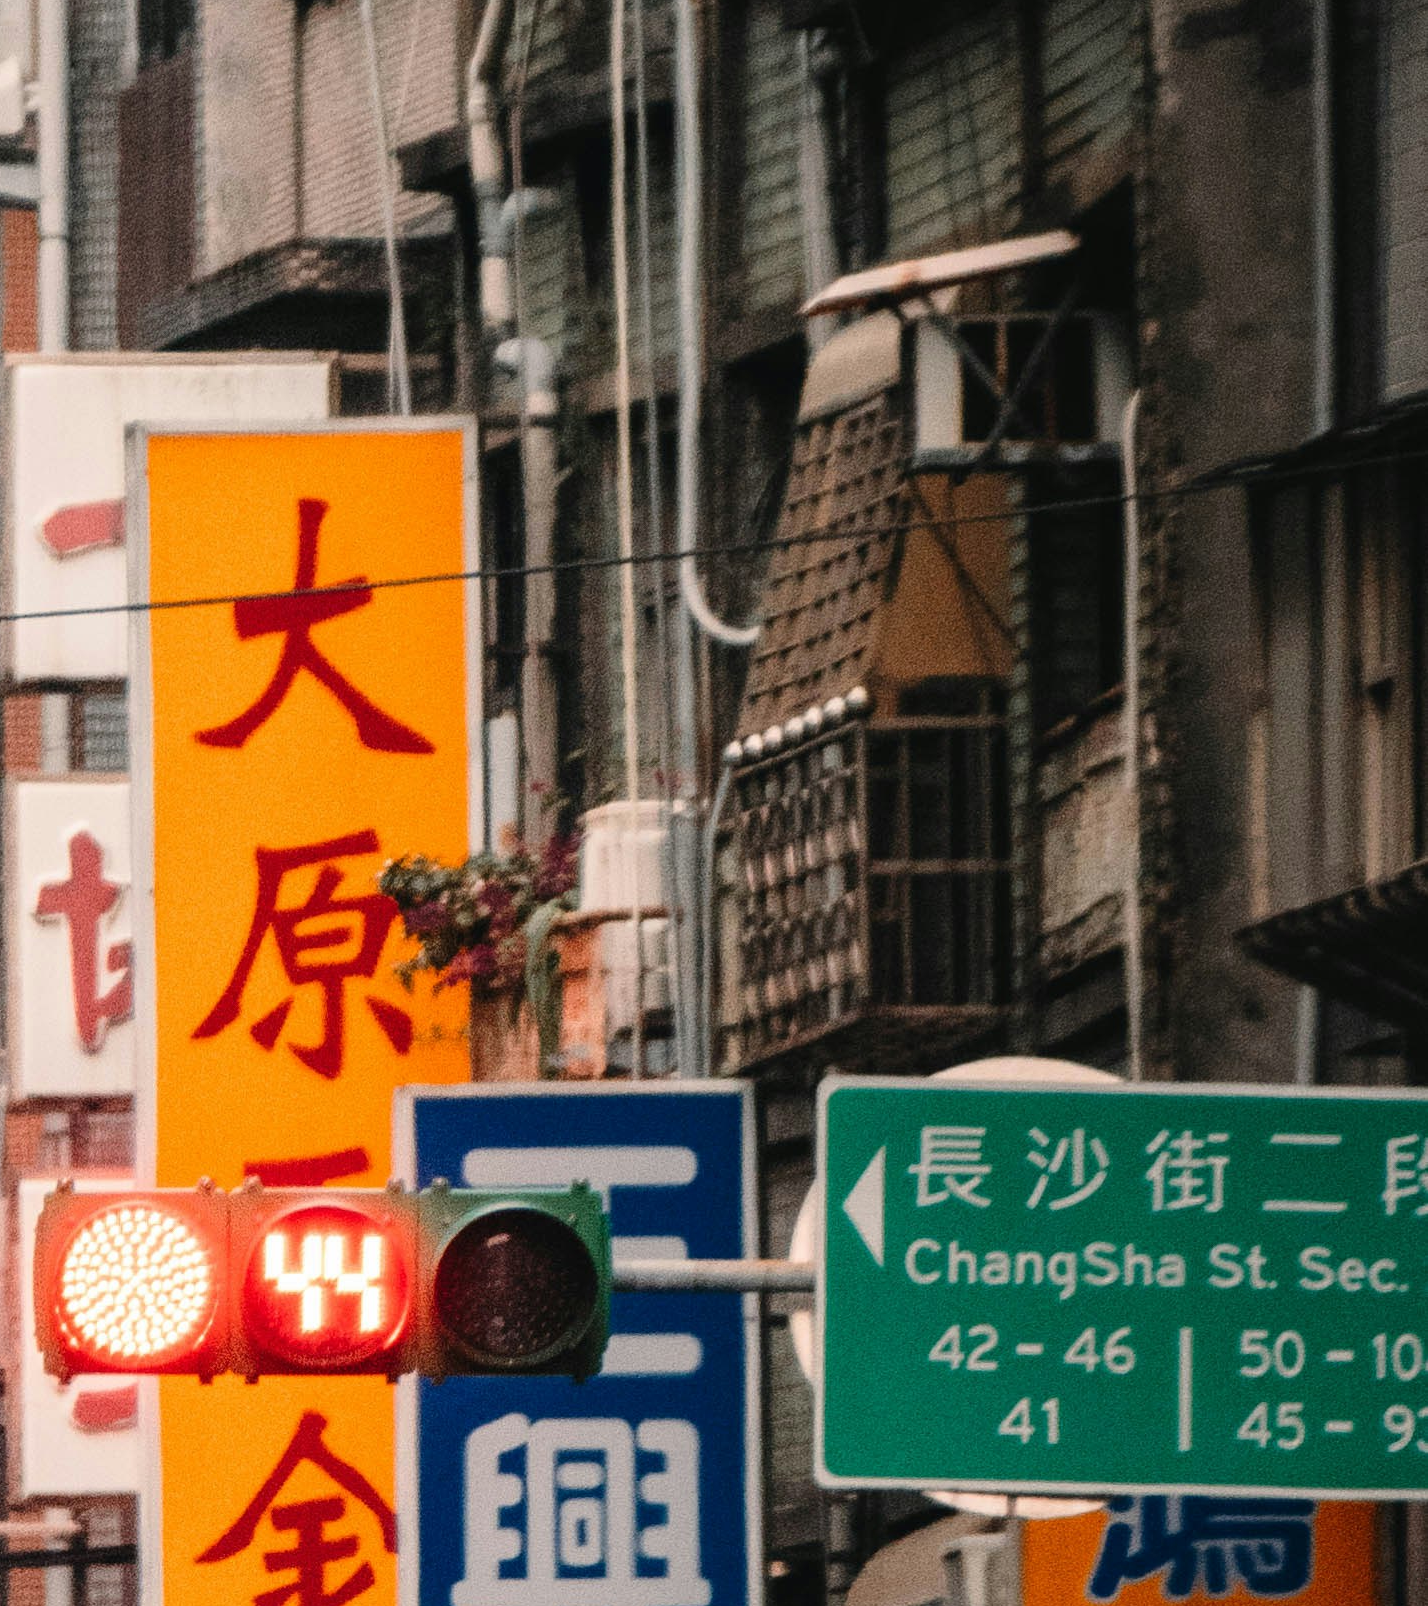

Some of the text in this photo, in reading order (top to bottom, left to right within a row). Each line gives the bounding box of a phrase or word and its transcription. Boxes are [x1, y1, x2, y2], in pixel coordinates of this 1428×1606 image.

[263, 1234, 383, 1332] 44
[905, 1238, 1408, 1300] ChangSha St. Sec.
[1372, 1333, 1428, 1381] 10
[998, 1398, 1059, 1444] 41
